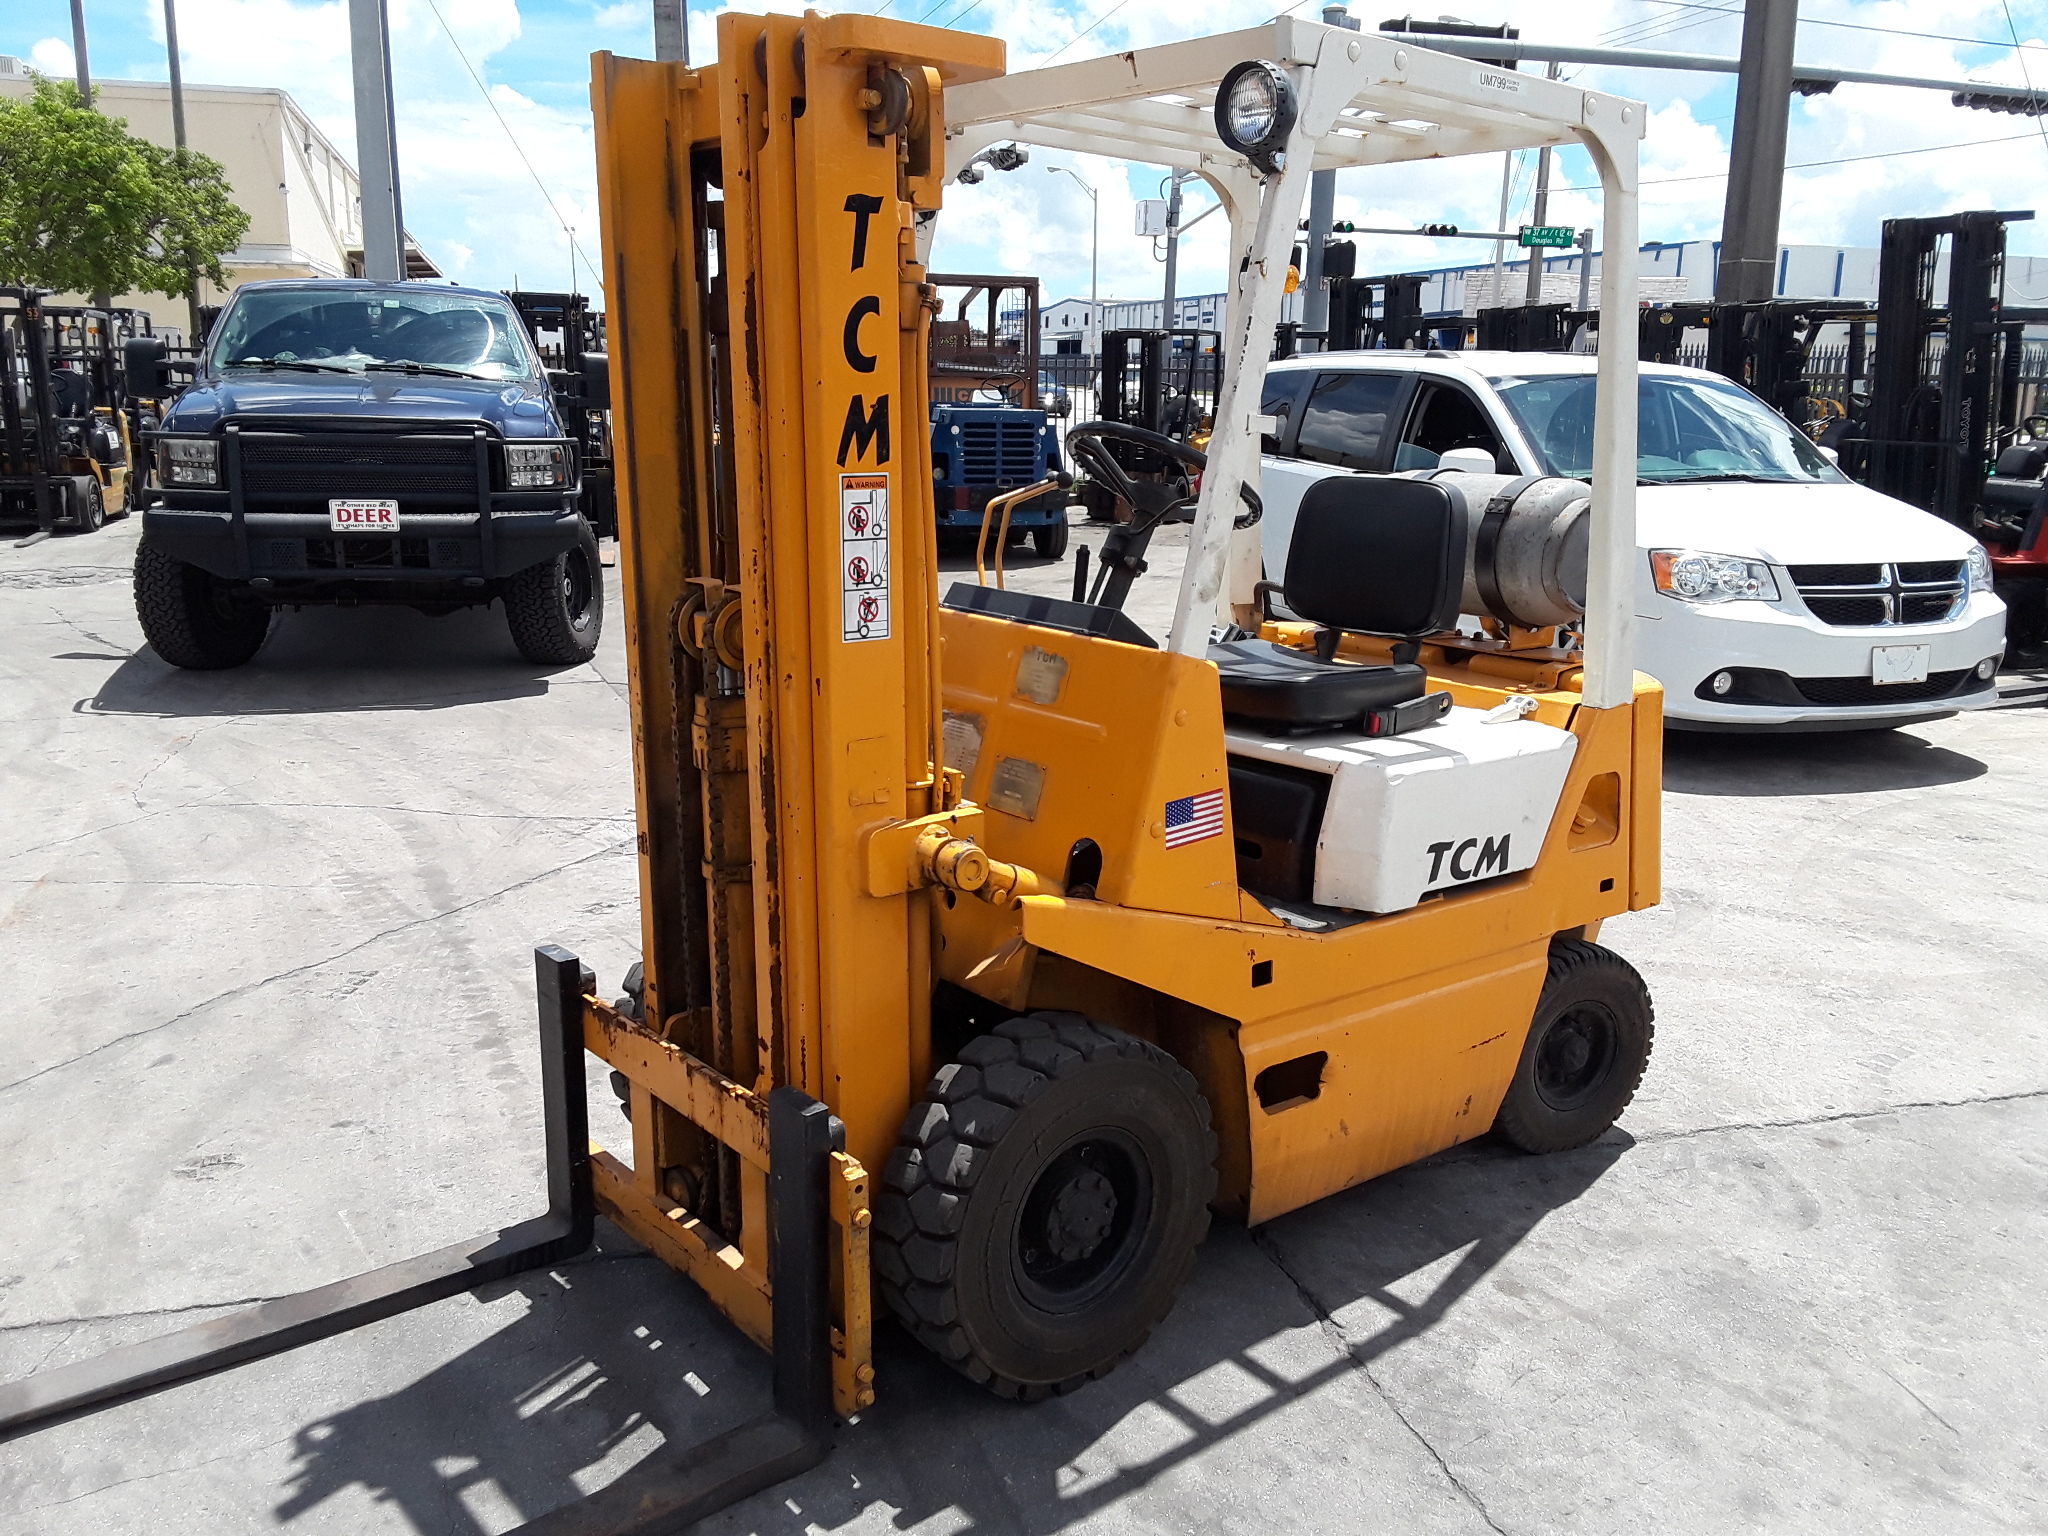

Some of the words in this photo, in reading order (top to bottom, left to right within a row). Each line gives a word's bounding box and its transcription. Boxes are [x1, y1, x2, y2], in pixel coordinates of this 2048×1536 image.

[1480, 72, 1507, 90] UM799
[1532, 228, 1540, 237] 37
[1532, 237, 1553, 245] Douglas
[836, 193, 890, 468] TCM
[1960, 396, 1972, 449] TOYOT
[854, 481, 885, 489] WARNING
[336, 508, 393, 523] DEER
[1036, 650, 1058, 665] TCM
[1426, 832, 1511, 886] TCM
